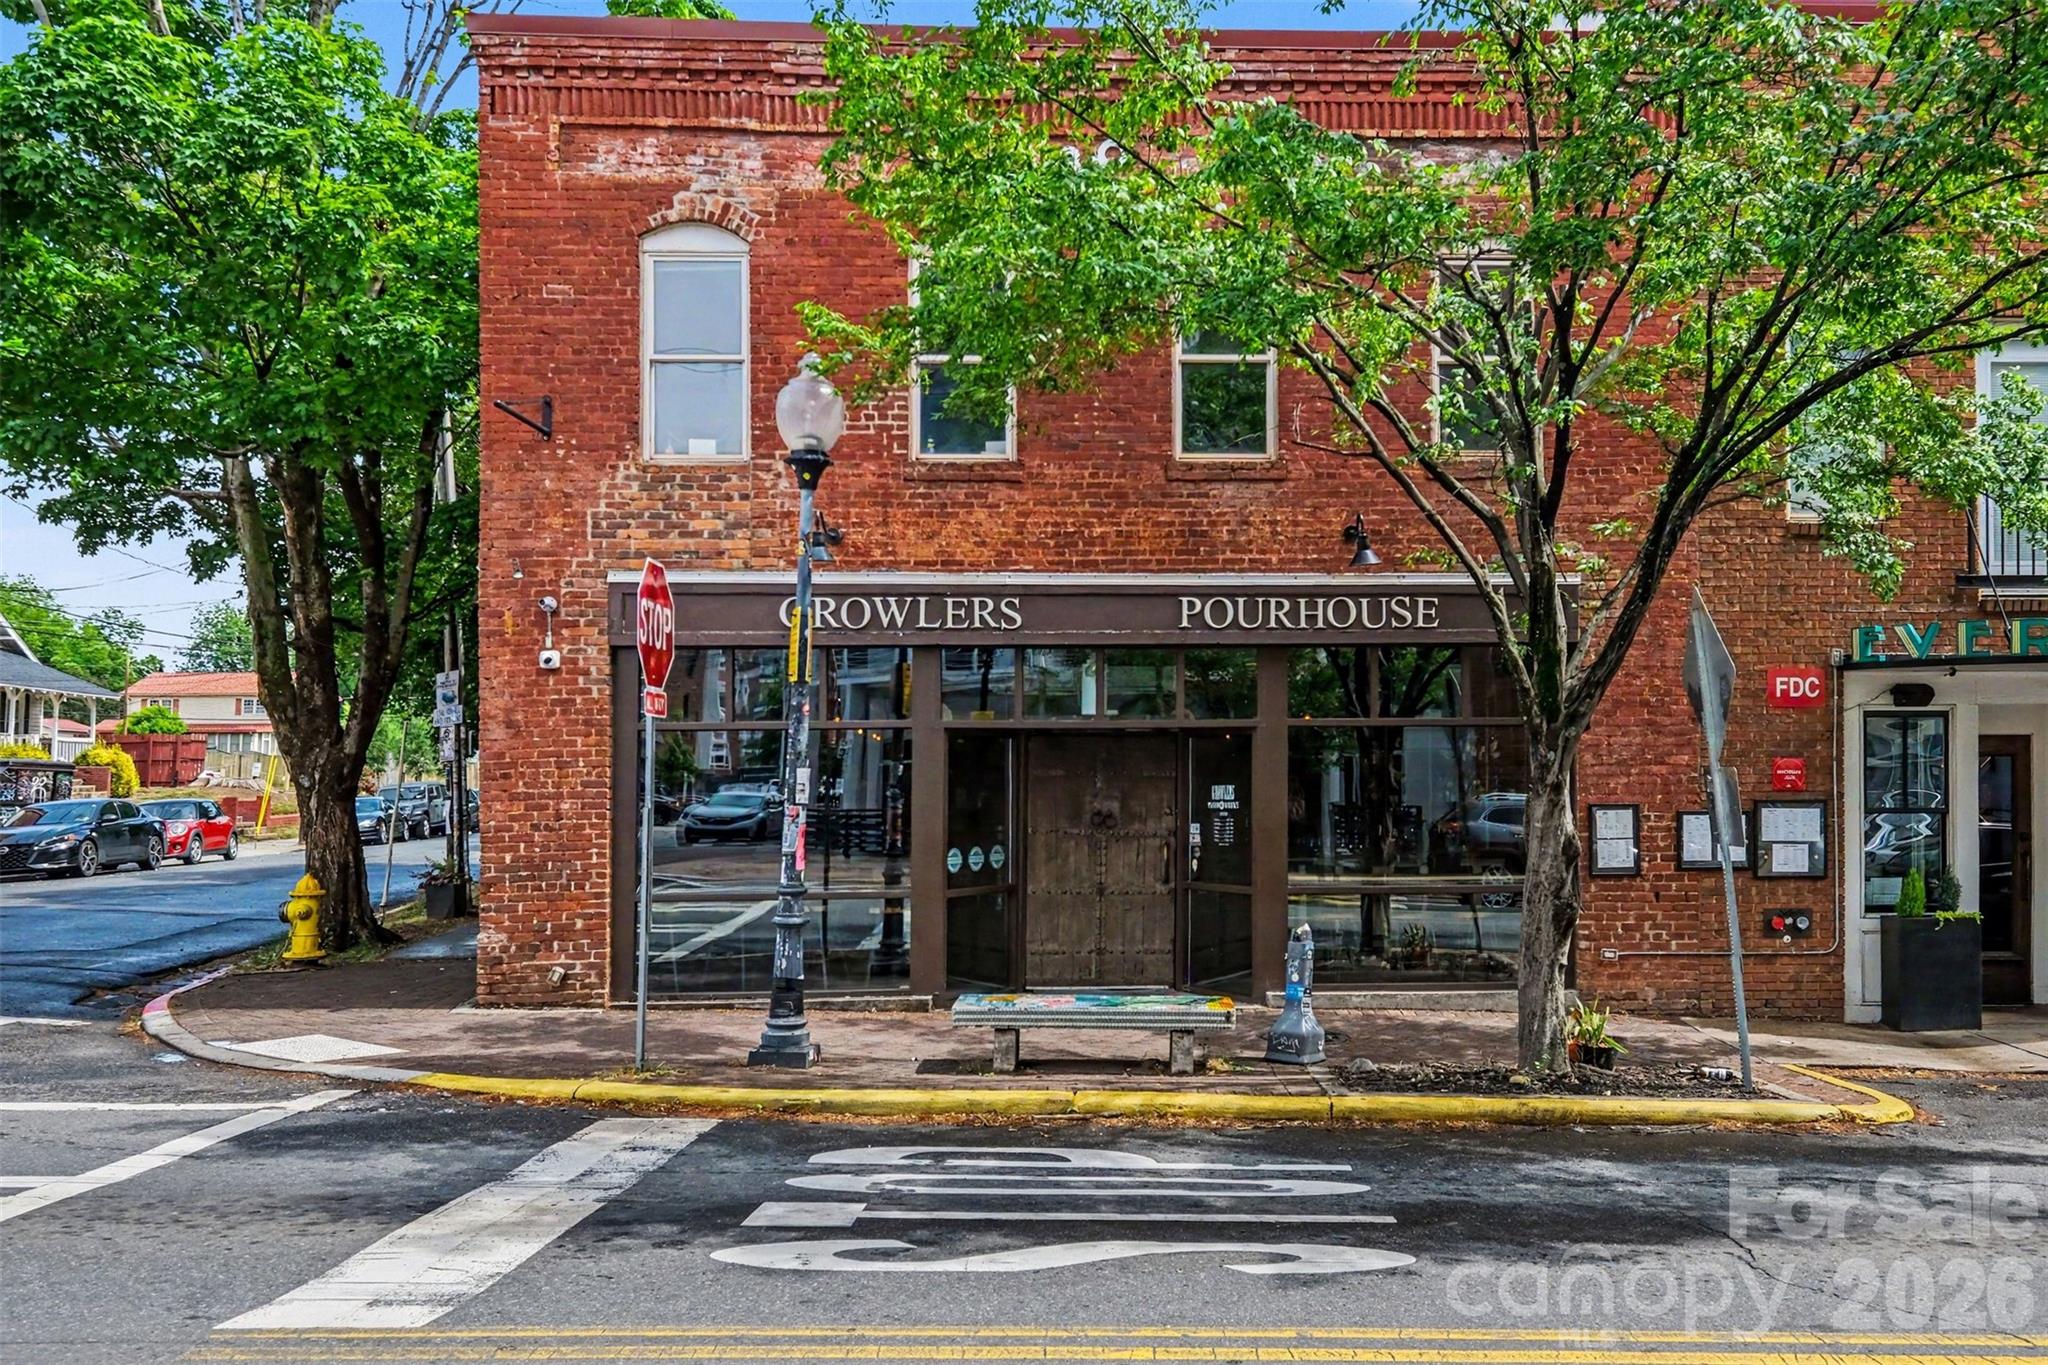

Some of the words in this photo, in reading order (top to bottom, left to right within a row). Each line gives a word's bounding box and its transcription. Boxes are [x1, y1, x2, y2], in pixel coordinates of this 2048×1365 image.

[640, 598, 671, 651] STOP
[1179, 596, 1440, 629] POURHOUSE
[1851, 617, 2048, 662] EVER
[1775, 676, 1821, 699] FDC
